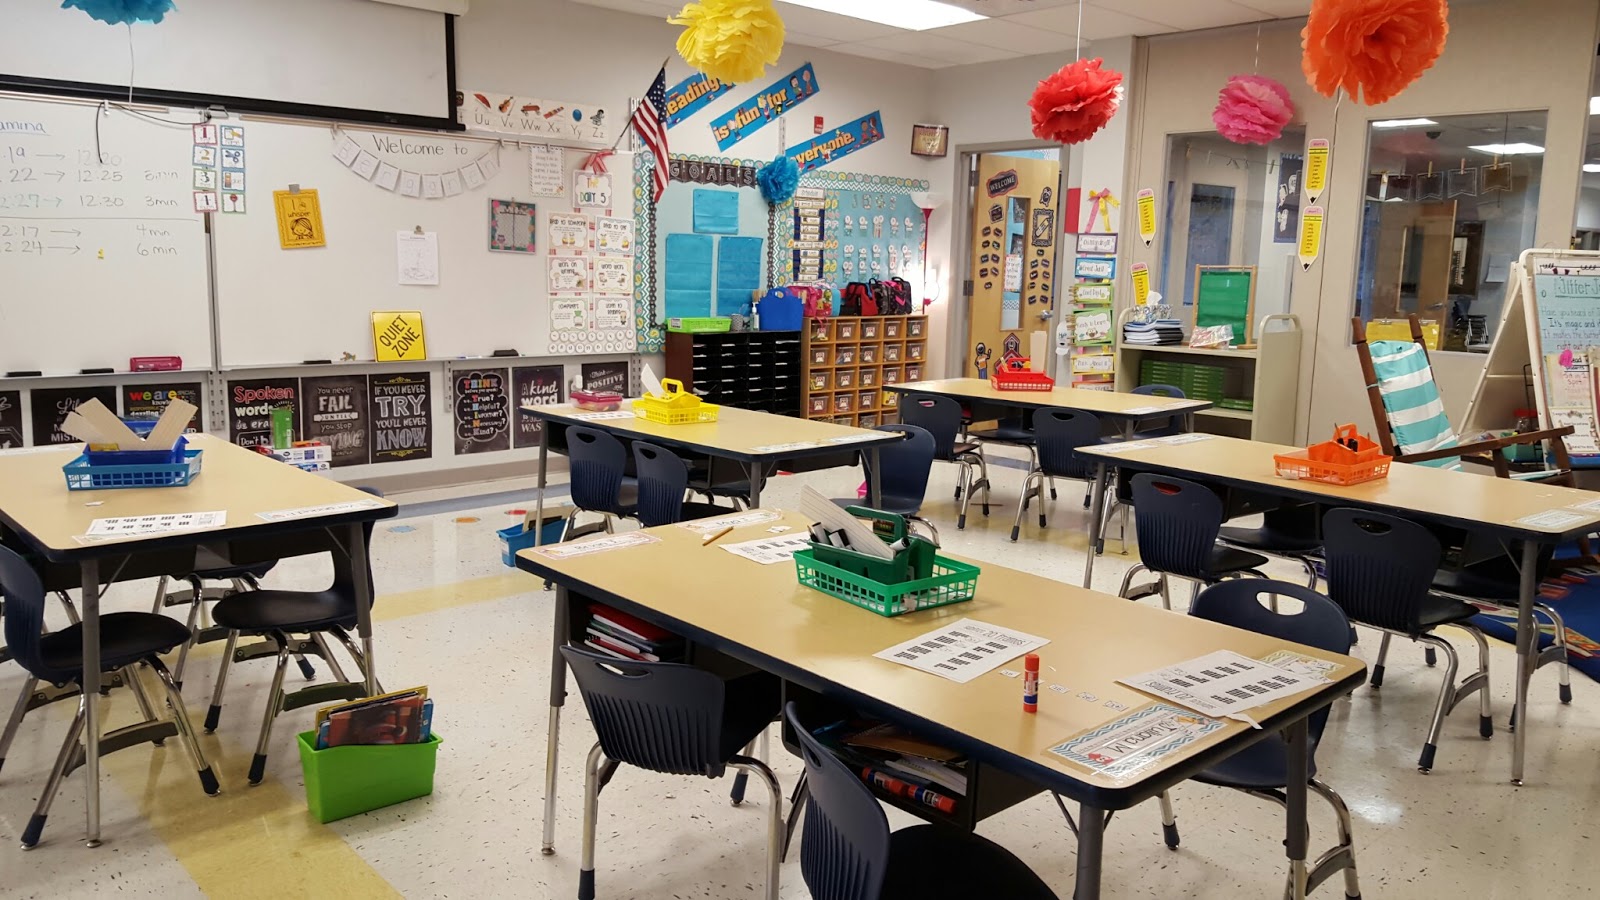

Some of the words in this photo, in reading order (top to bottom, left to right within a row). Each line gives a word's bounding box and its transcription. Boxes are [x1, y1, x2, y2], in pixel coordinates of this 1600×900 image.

[666, 78, 720, 118] eading
[713, 126, 730, 142] is
[734, 106, 760, 129] fun
[766, 88, 787, 108] for
[202, 127, 207, 138] 1
[475, 113, 490, 126] Uu
[501, 117, 513, 128] Vv
[520, 118, 541, 131] Ww
[547, 122, 561, 133] Xx
[571, 125, 582, 139] Yy
[372, 134, 444, 155] Welcome
[455, 143, 468, 155] to
[200, 149, 210, 160] 2
[669, 163, 753, 185] GOALS
[990, 176, 1016, 191] WELCOME
[600, 193, 606, 203] 5
[152, 247, 178, 256] min
[379, 314, 408, 347] QUIET
[391, 327, 420, 358] ZONE
[463, 378, 498, 389] THINK
[522, 383, 529, 396] A
[529, 380, 559, 395] kind
[587, 374, 624, 390] POSITIVE
[129, 391, 152, 401] we
[154, 390, 177, 400] are
[234, 386, 294, 404] Spoken
[375, 386, 381, 396] IF
[383, 386, 400, 395] YOU
[401, 384, 426, 394] NEVER
[319, 395, 352, 412] FAIL
[472, 394, 494, 402] True?
[520, 393, 558, 406] word
[375, 395, 426, 418] TRY,
[472, 403, 500, 411] Helpful?
[321, 424, 335, 432] you
[376, 419, 401, 428] YOU'LL
[403, 417, 427, 426] NEVER
[376, 427, 427, 451] KNOW.
[473, 428, 494, 436] Kind?
[241, 436, 259, 445] Don't
[1125, 720, 1177, 745] Juliana
